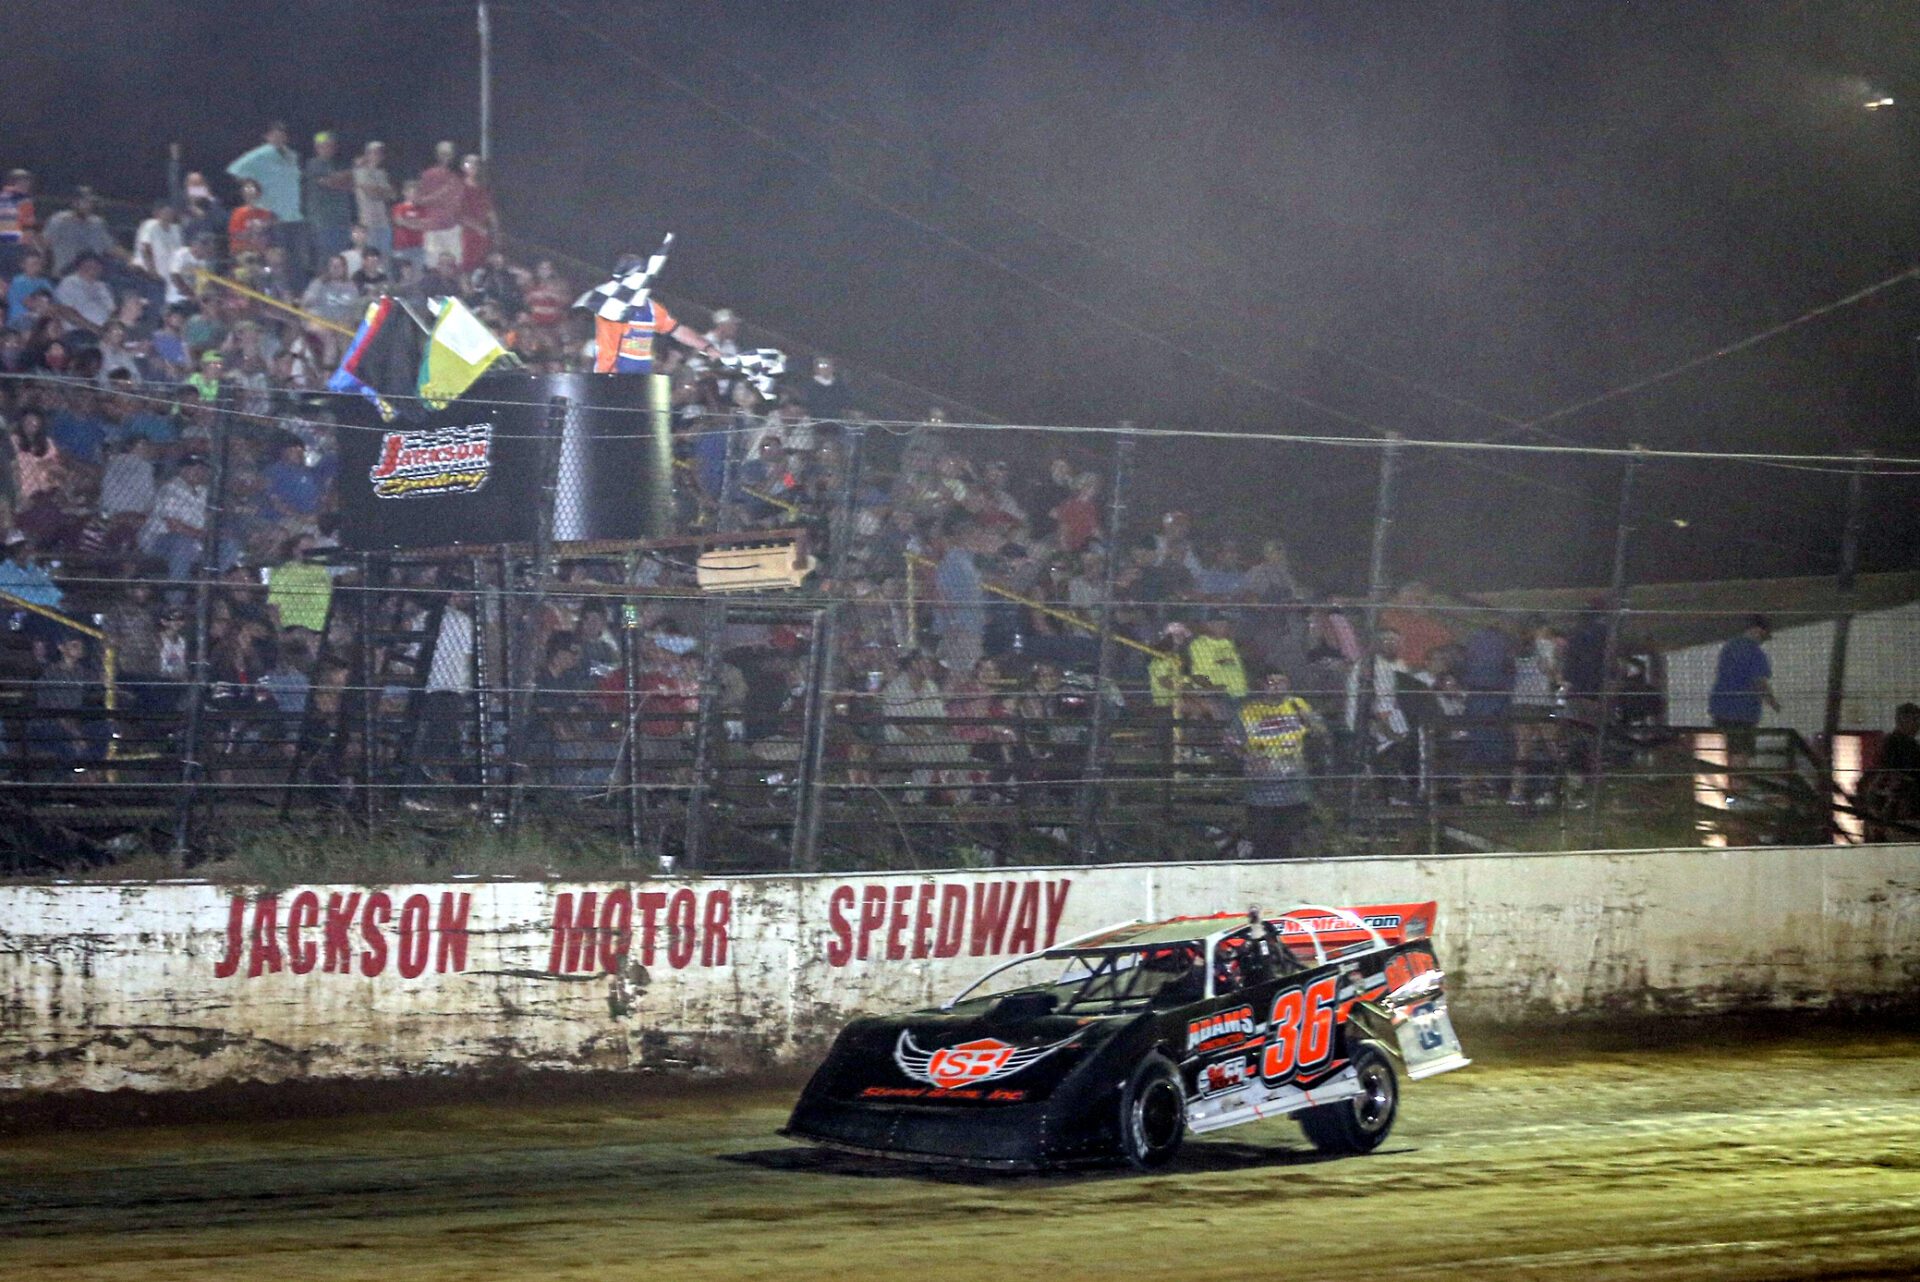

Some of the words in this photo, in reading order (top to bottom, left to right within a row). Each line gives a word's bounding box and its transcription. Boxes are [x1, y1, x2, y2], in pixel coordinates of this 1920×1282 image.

[374, 434, 488, 477] JACKSON
[214, 890, 471, 979] JACKSON
[548, 888, 732, 974] MOTOR
[826, 878, 1071, 968] SPEEDWAY
[1187, 1006, 1255, 1051] ADAMS
[1262, 974, 1338, 1081] 36
